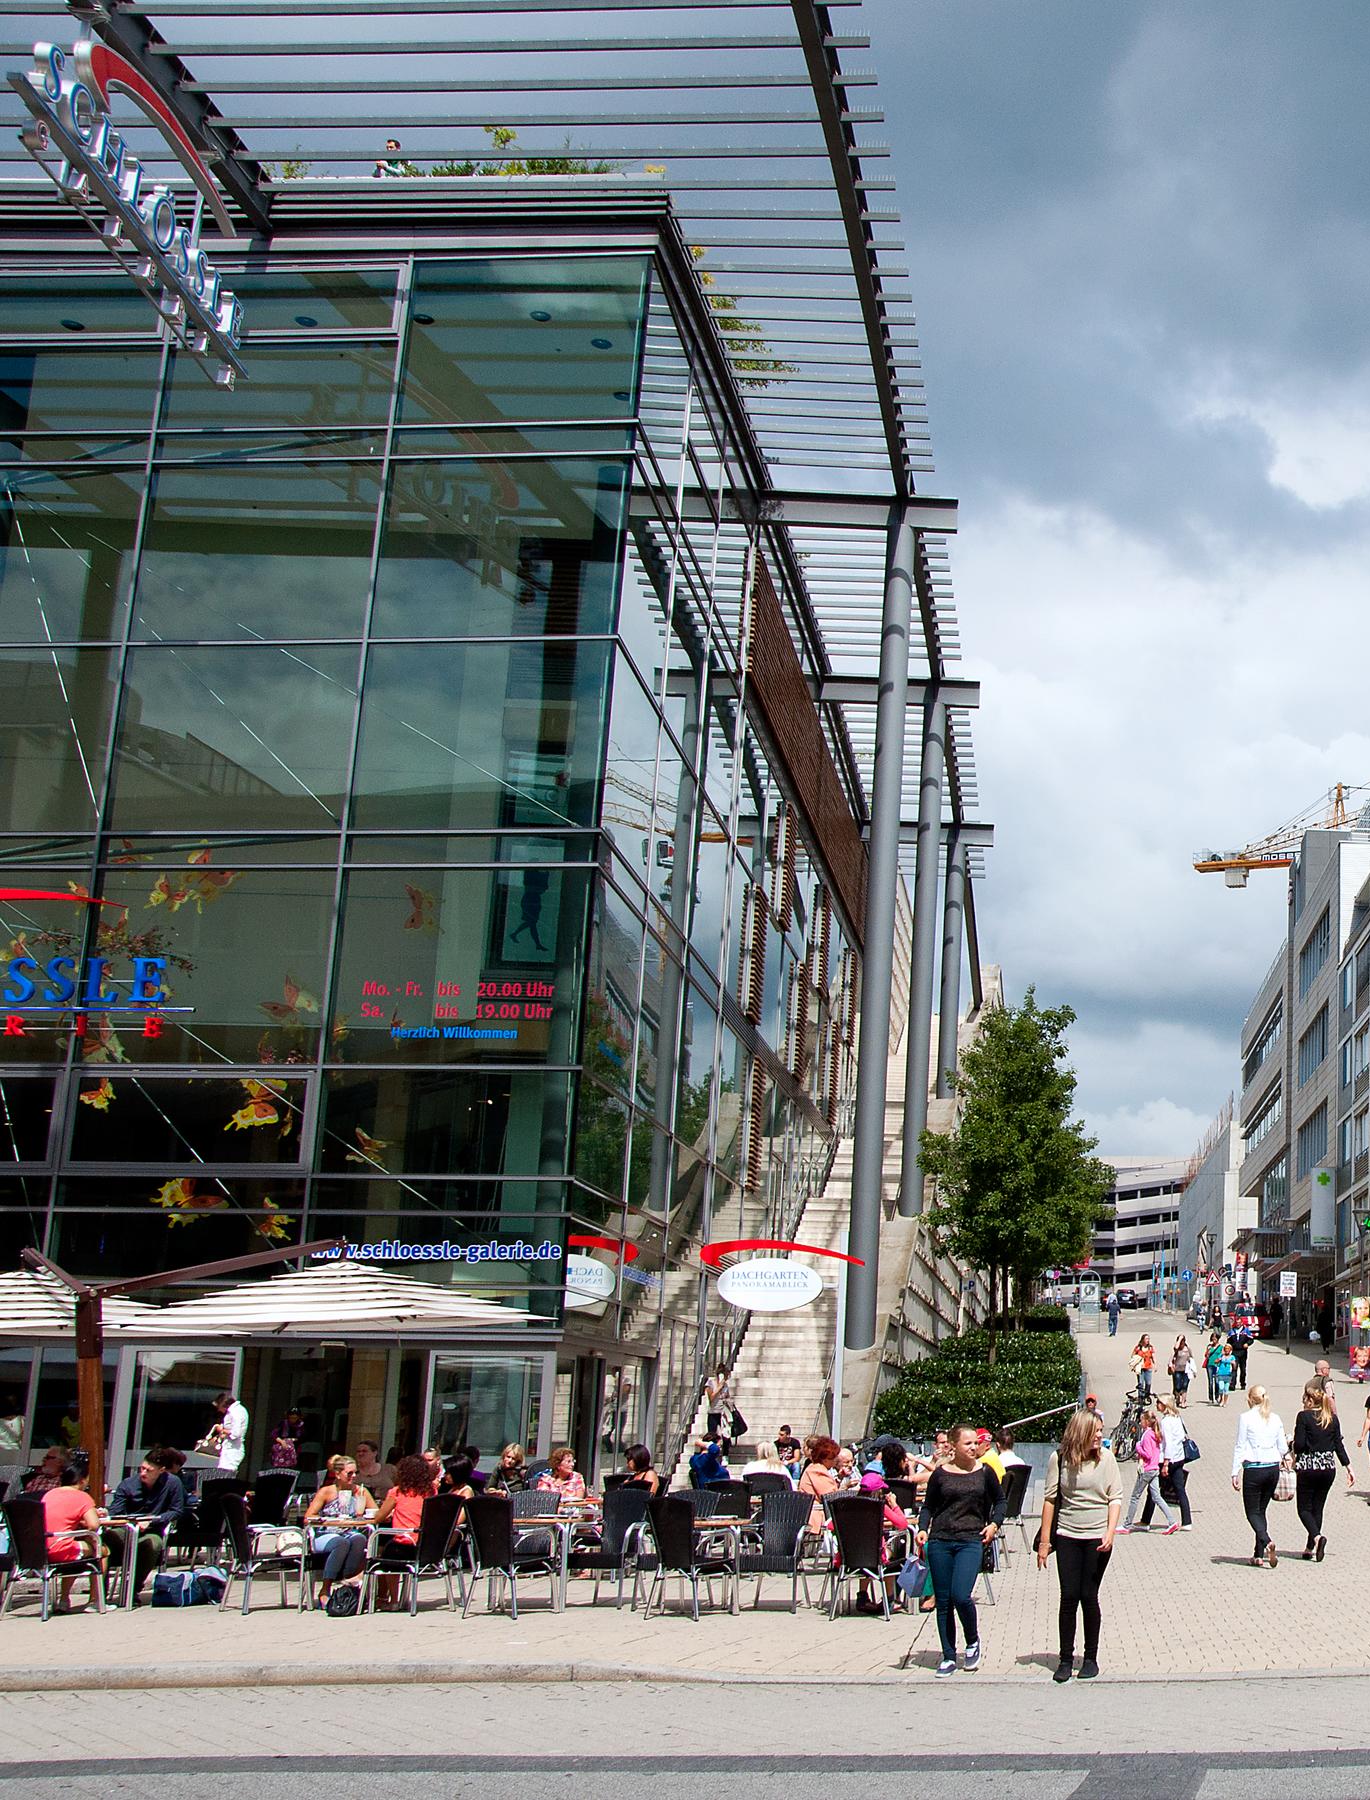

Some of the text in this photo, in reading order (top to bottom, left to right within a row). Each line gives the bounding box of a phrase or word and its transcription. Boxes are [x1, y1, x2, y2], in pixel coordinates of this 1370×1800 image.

[362, 981, 391, 996] Mo.
[405, 981, 425, 996] Fr.
[437, 981, 461, 997] bis
[478, 982, 521, 997] 20.00
[526, 982, 555, 998] Uhr
[361, 1002, 554, 1019] Sa. bis 19.00 Uhr
[391, 1026, 518, 1039] Herzlich Willkommen
[731, 1271, 809, 1280] DACHGARTEN
